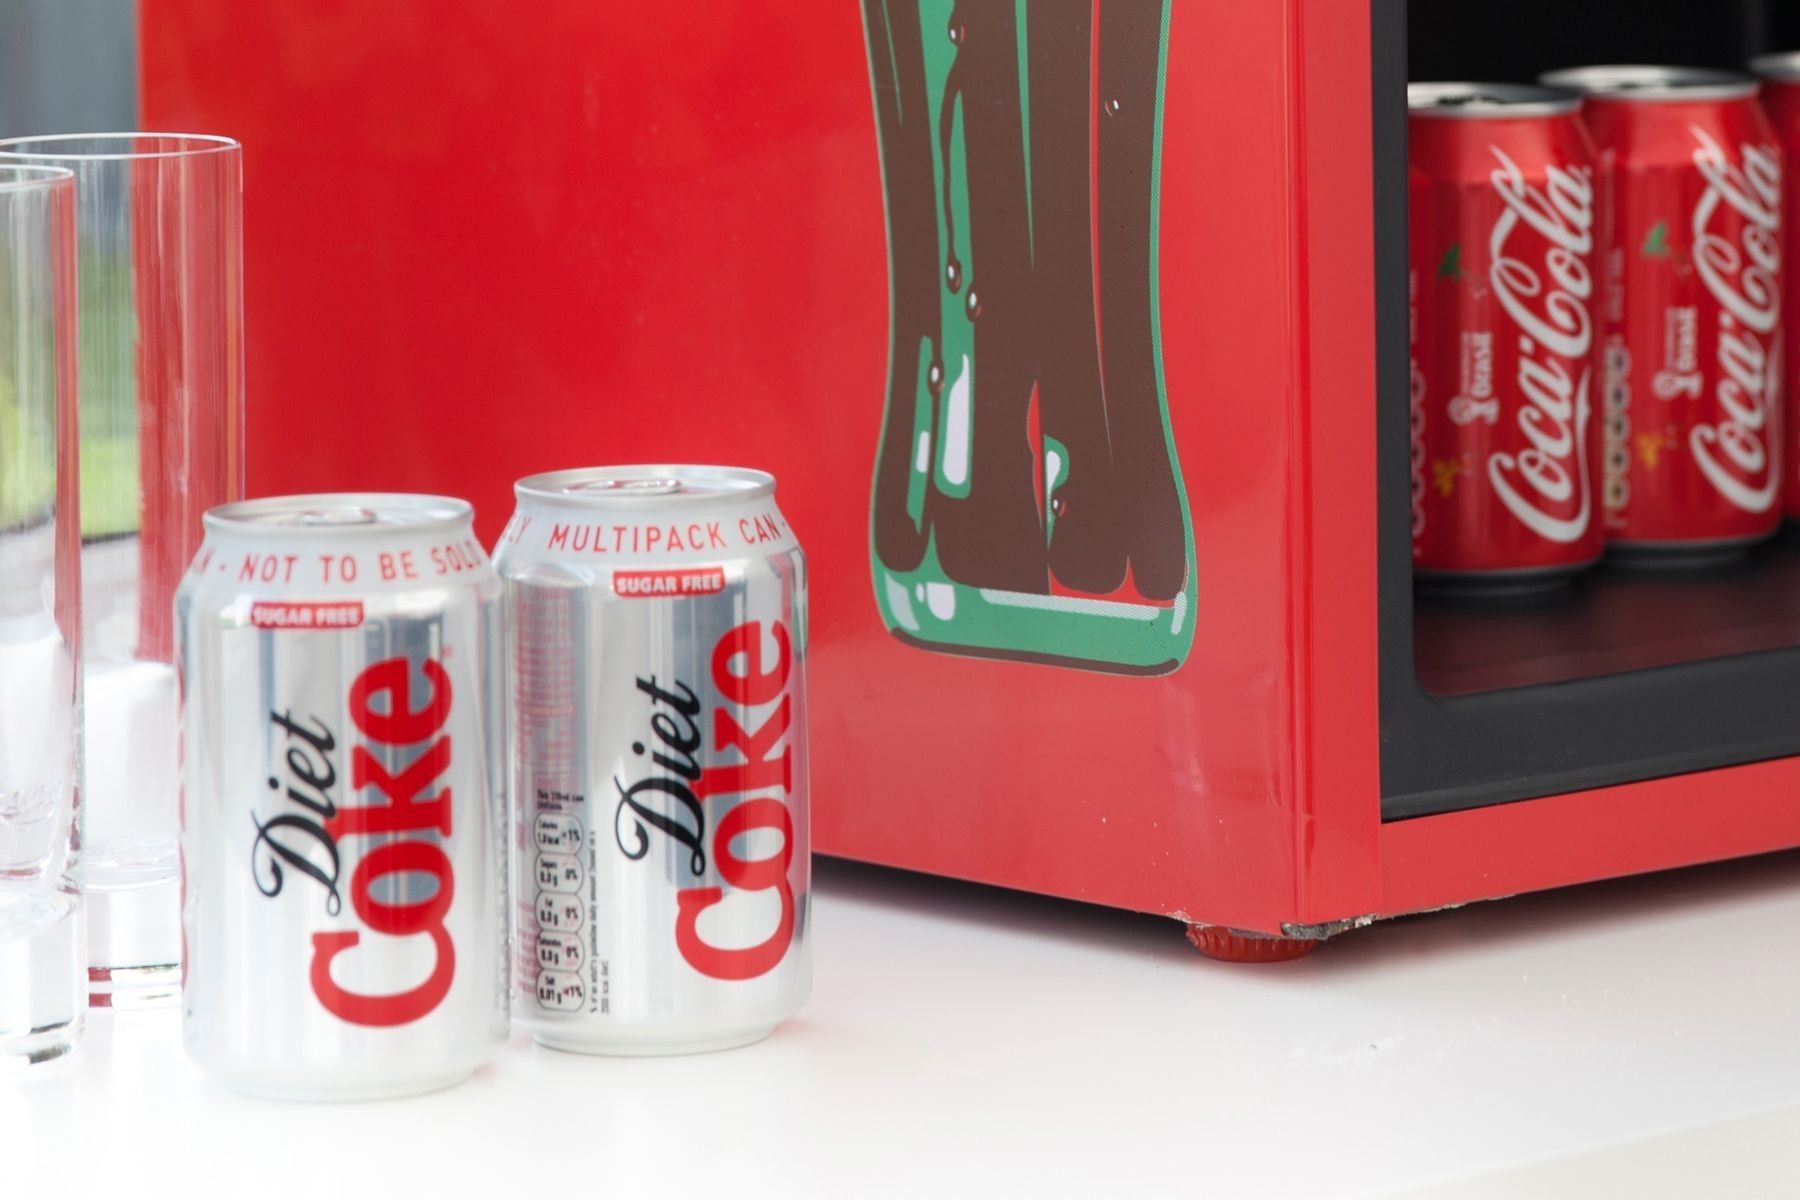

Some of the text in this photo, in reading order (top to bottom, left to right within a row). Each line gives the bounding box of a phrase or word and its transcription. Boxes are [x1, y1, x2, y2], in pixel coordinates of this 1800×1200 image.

[1489, 144, 1593, 541] Coca-Cola
[1689, 123, 1782, 513] Coca-Cola
[239, 553, 299, 584] NOT
[318, 553, 358, 583] TO
[380, 551, 418, 580] BE
[254, 605, 360, 626] SUGAR FREE
[548, 521, 728, 554] MULTIPACK
[739, 513, 782, 545] CAN
[615, 572, 722, 595] SUGAR FREE
[251, 708, 340, 917] Diet
[310, 656, 456, 1028] Coke
[613, 674, 706, 878] Diet
[675, 619, 796, 981] Coke
